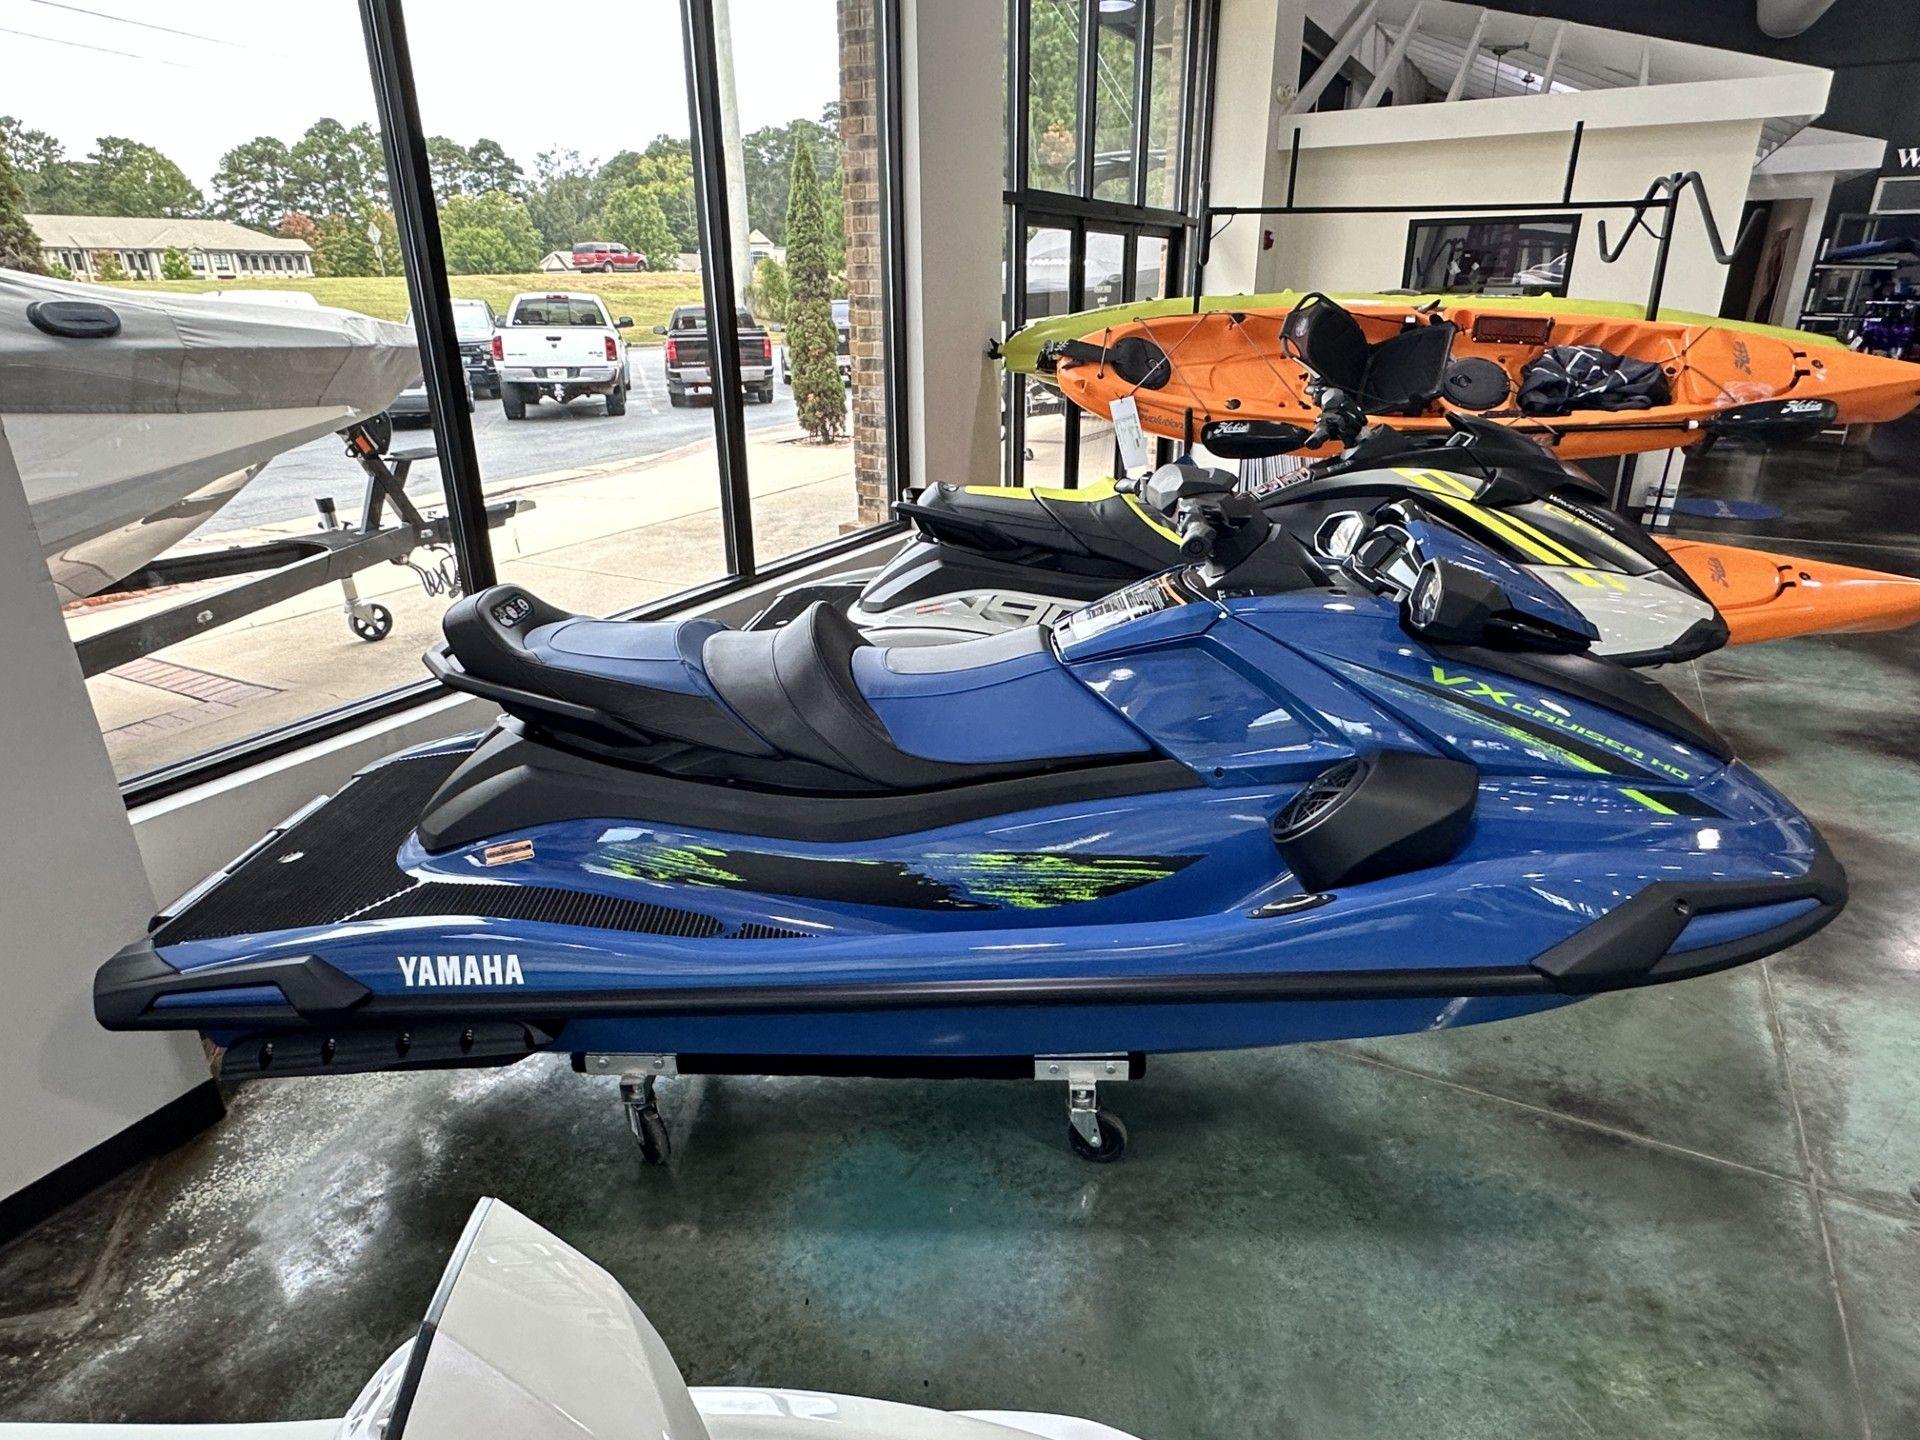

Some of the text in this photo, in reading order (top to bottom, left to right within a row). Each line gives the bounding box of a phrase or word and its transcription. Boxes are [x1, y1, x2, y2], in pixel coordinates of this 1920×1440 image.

[1780, 400, 1823, 414] Hobie
[1214, 422, 1250, 435] Hobie
[1431, 665, 1690, 781] VX CRUISER HO
[397, 954, 525, 986] YAMAHA
